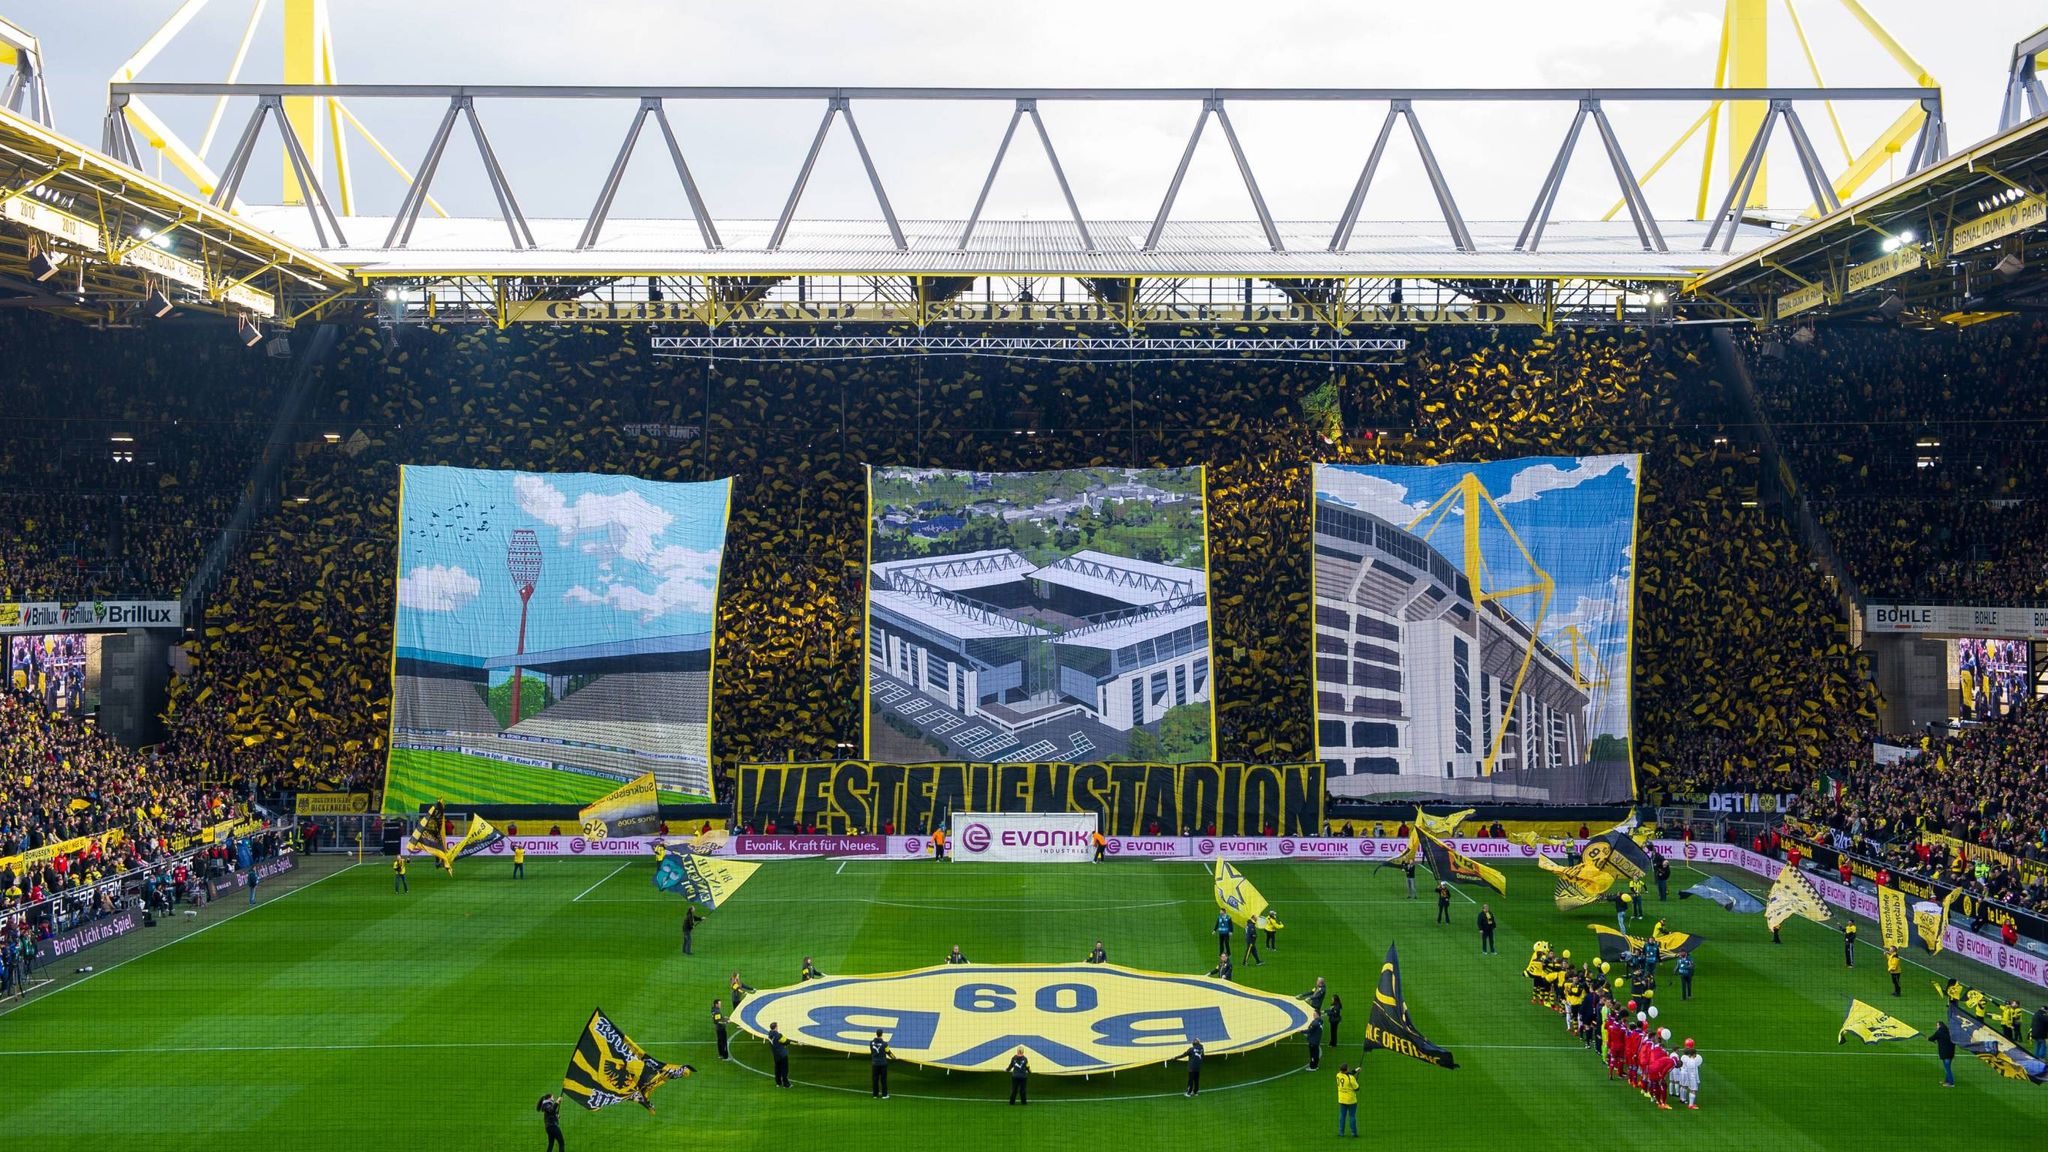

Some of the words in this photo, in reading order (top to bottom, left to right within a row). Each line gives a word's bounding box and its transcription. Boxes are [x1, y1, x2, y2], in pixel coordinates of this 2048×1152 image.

[1954, 225, 1981, 247] SIGNAL
[1982, 216, 2006, 237] IDUNA
[2022, 202, 2044, 222] PARK
[1849, 272, 1871, 287] SIGNAL
[1871, 261, 1890, 280] IDUNA
[546, 302, 695, 319] GELBE
[725, 302, 856, 319] WAND
[32, 607, 58, 626] Brillux
[69, 606, 93, 625] Brillux
[109, 605, 171, 623] Brillux
[1877, 609, 1931, 623] BOHLE
[1974, 611, 1997, 625] BOHLE
[511, 841, 559, 850] EVONIK
[591, 841, 640, 850] EVONIK
[745, 840, 785, 851] Evonik.
[789, 840, 818, 851] Kraft
[819, 840, 835, 851] für
[837, 840, 879, 851] Neues.
[1002, 830, 1089, 846] EVONIK
[1126, 842, 1175, 851] EVONIK
[1220, 842, 1268, 851] EVONIK
[1300, 842, 1349, 851] EVONIK
[1461, 843, 1510, 852] EVONIK
[1702, 848, 1739, 859] EVONIK
[1827, 886, 1847, 901] EVONIK
[53, 932, 80, 956] Bringt
[80, 925, 100, 946] Licht
[101, 923, 113, 938] ins
[113, 914, 135, 936] Spiel.
[1966, 939, 1993, 959] EVONIK
[2009, 955, 2038, 975] EVONIK
[953, 982, 1099, 1014] 09
[797, 1004, 1232, 1066] BVB
